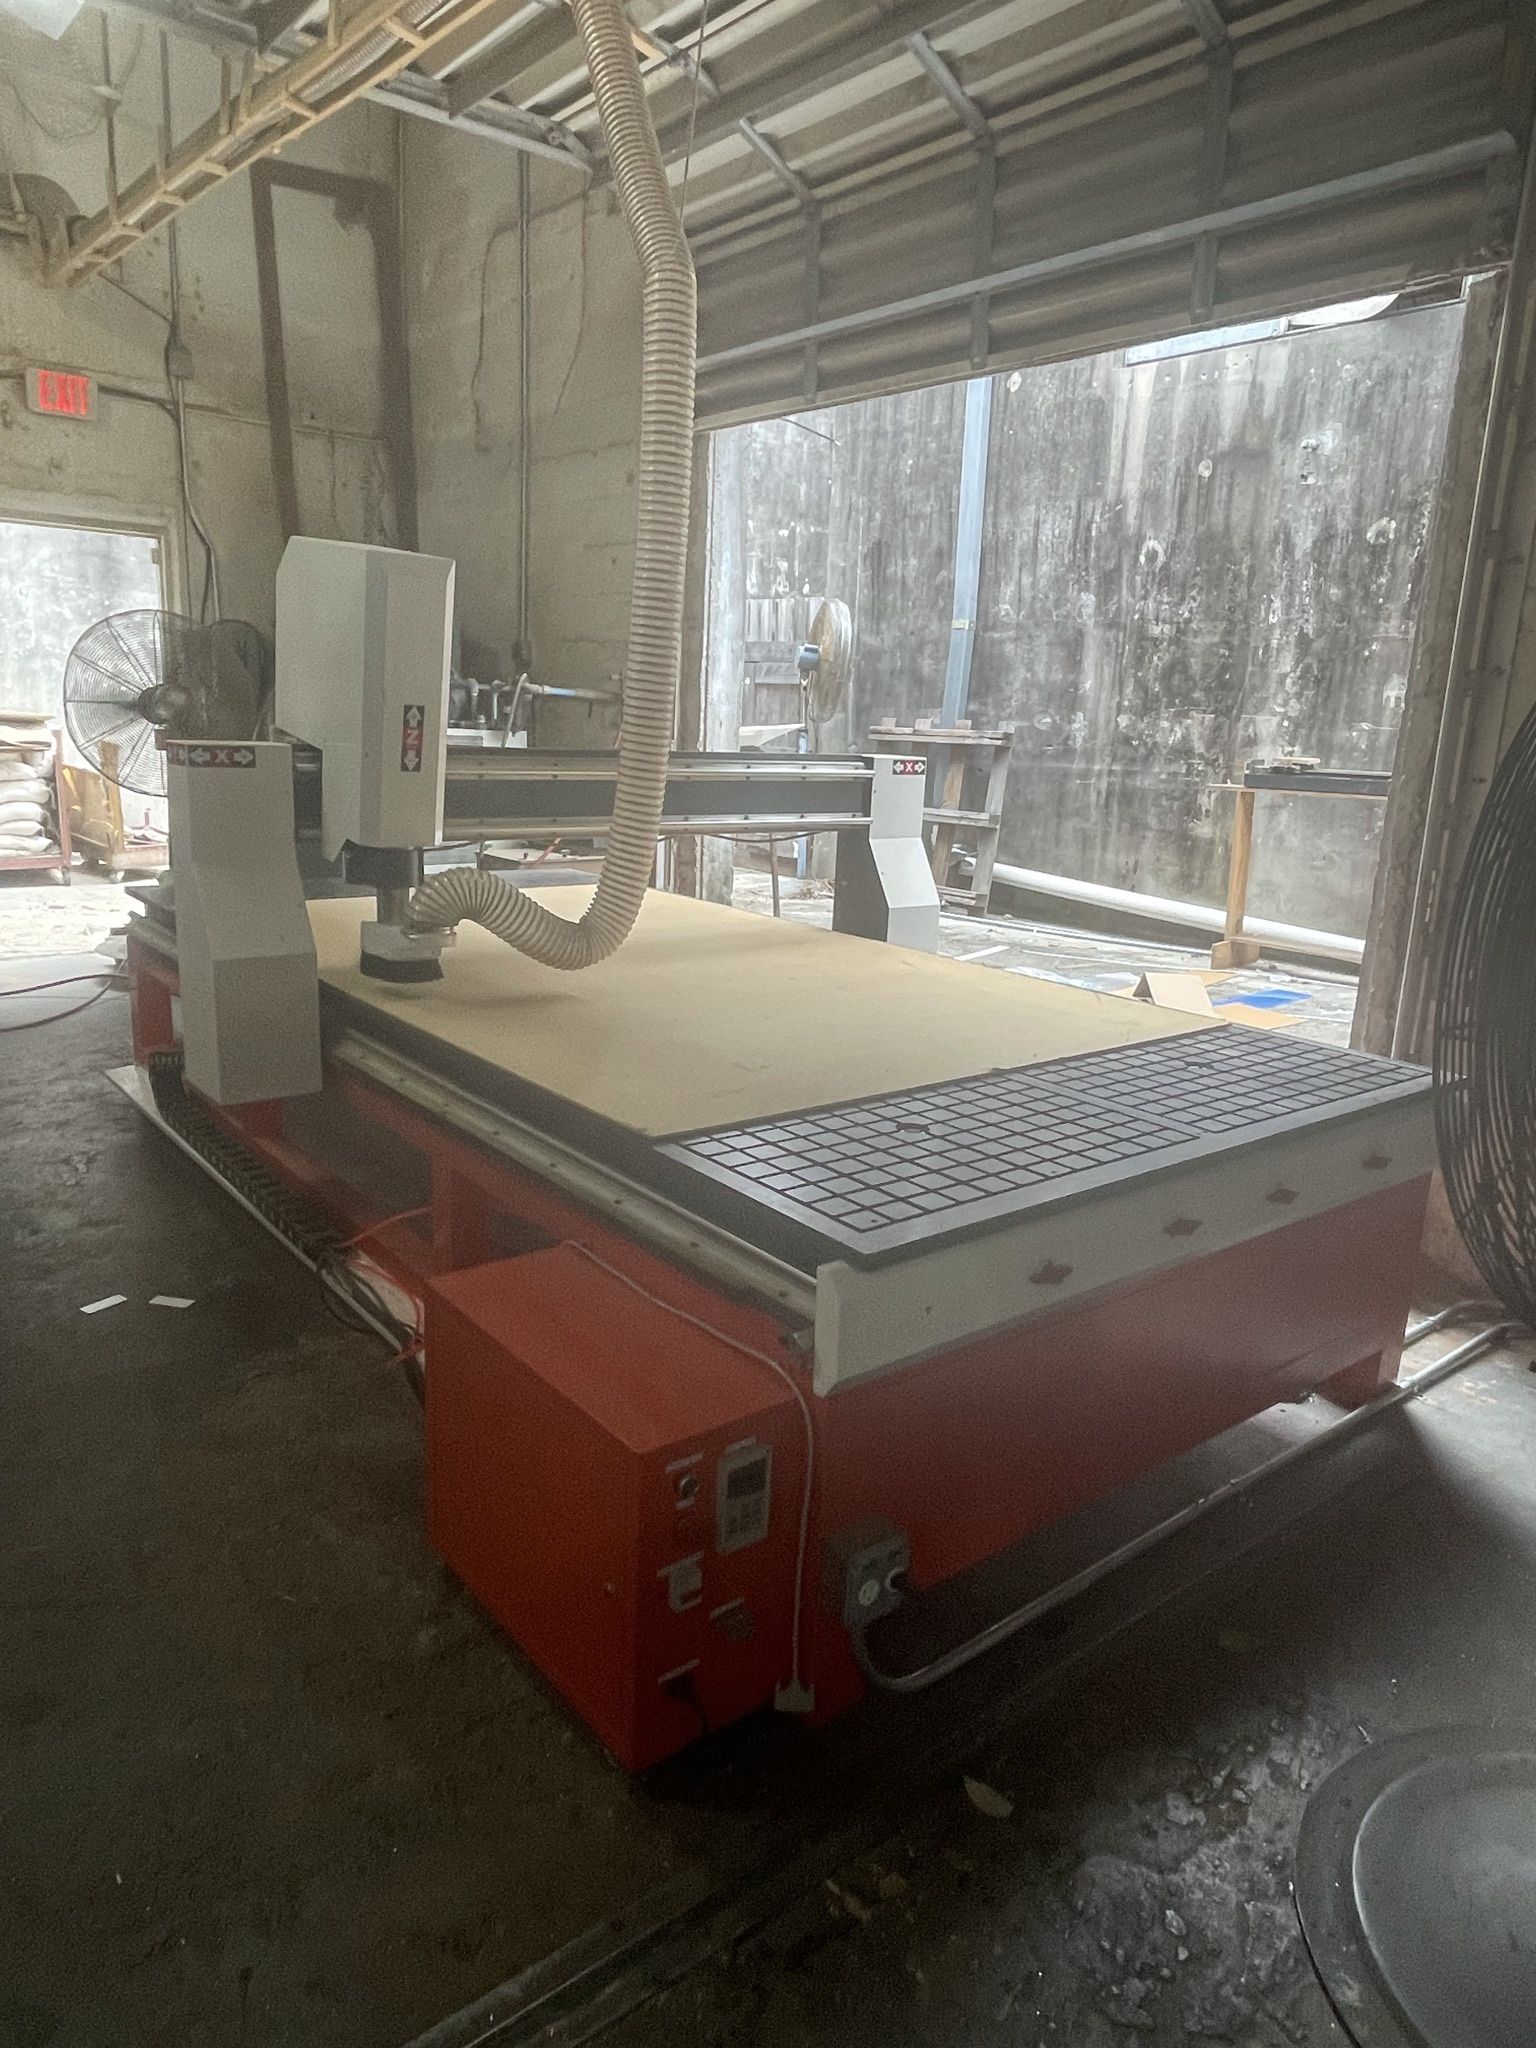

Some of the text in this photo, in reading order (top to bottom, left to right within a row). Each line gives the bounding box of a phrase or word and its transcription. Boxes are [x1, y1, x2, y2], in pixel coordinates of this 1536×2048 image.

[39, 370, 88, 416] EXIT
[407, 729, 419, 745] Z
[214, 749, 230, 764] X
[905, 761, 914, 773] X
